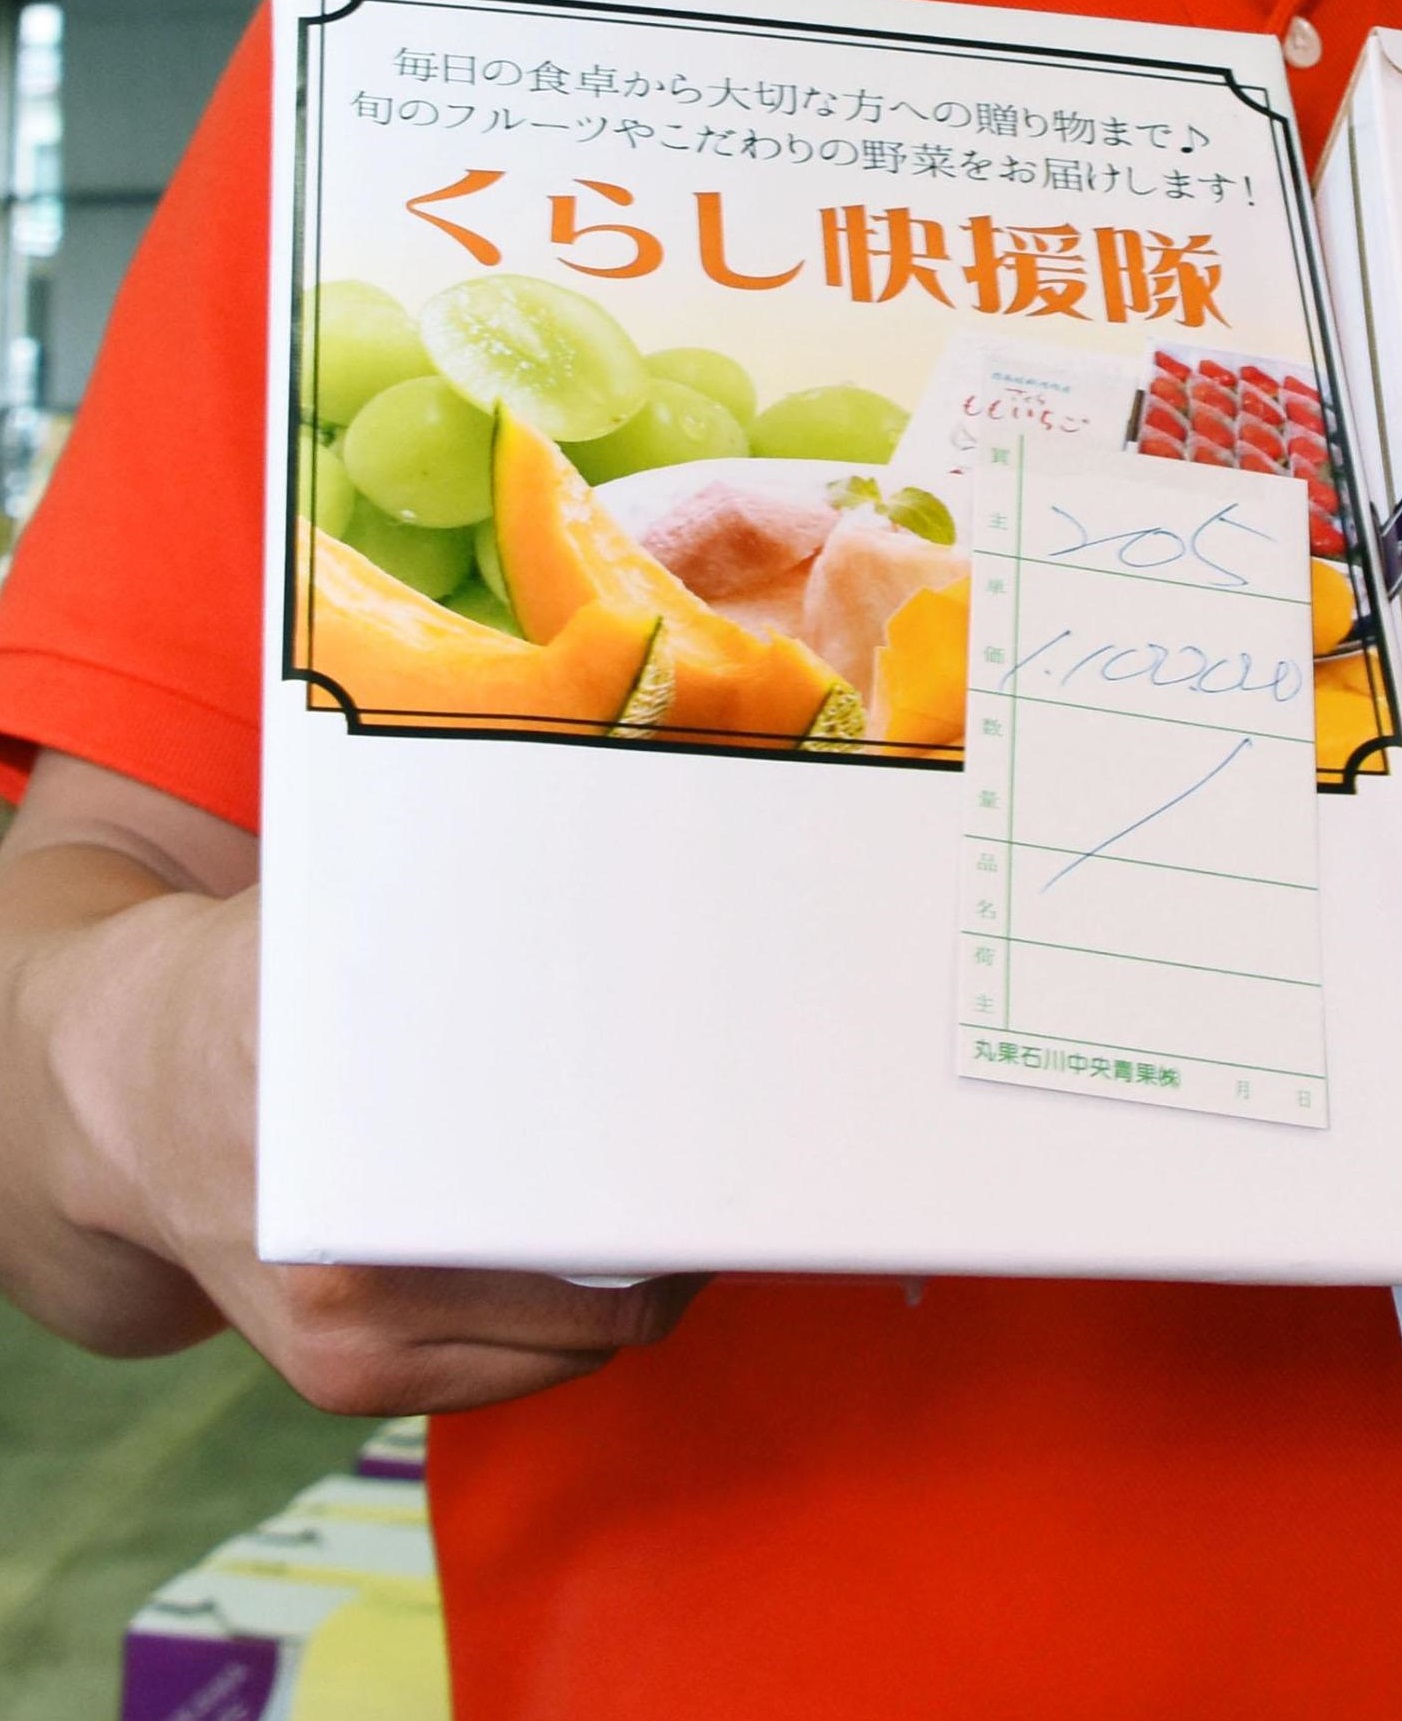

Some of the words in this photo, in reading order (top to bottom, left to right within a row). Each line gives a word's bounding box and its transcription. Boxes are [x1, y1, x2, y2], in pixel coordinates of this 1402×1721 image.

[404, 169, 1232, 329] くらし快援隊
